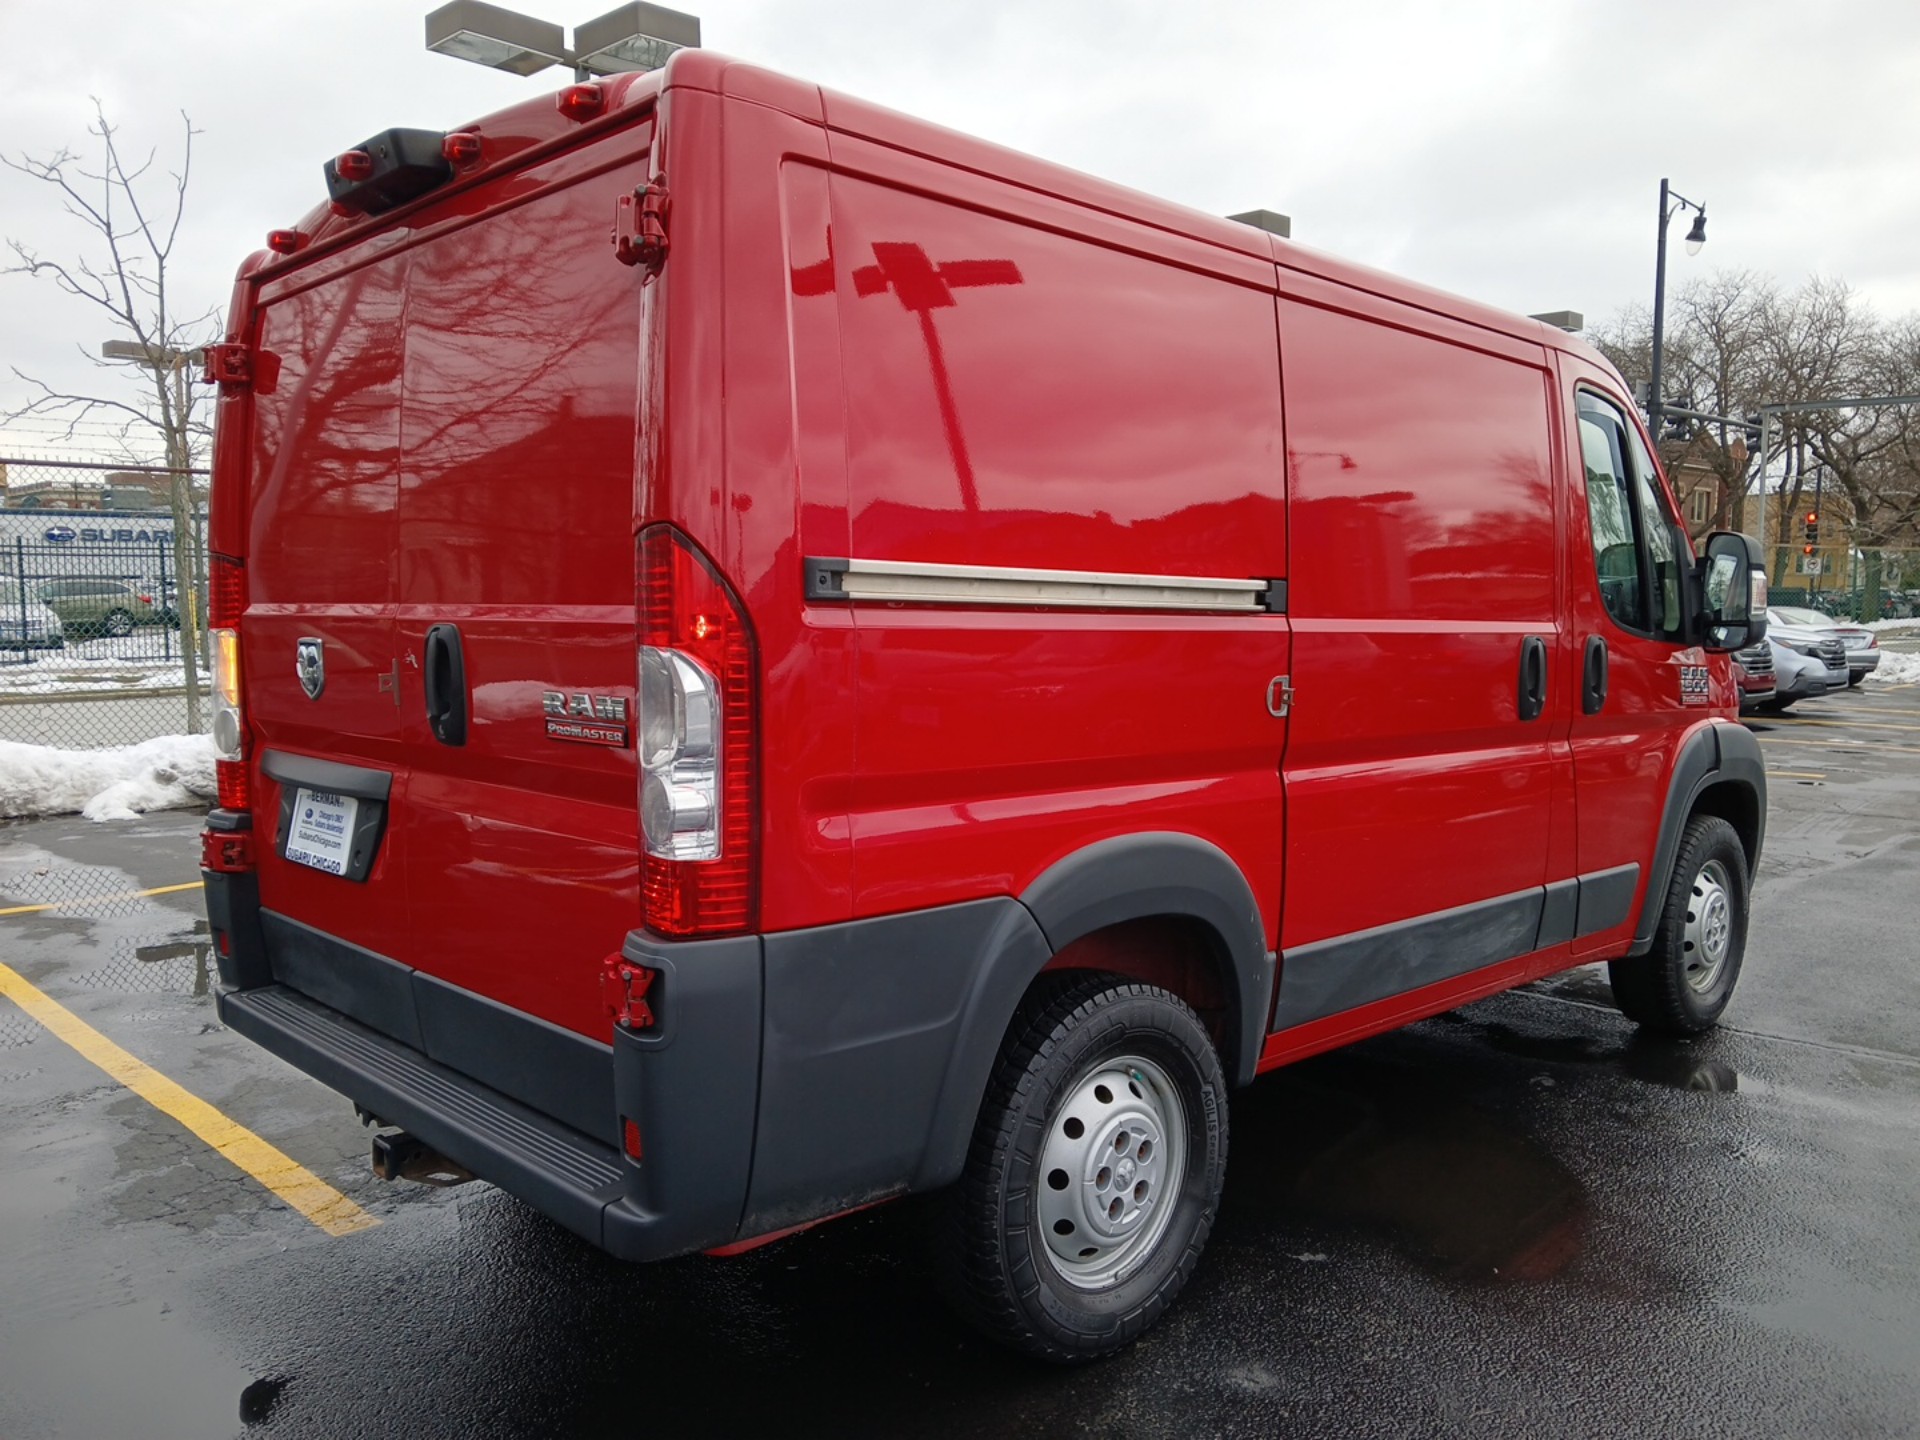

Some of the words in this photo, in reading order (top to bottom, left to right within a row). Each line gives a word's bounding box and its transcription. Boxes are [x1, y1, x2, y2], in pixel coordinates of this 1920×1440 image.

[542, 690, 628, 721] RAM
[547, 722, 623, 742] PROMASTER
[312, 790, 340, 807] BERMAN
[312, 855, 341, 873] CHICAGO
[1202, 1090, 1217, 1132] AGILIS
